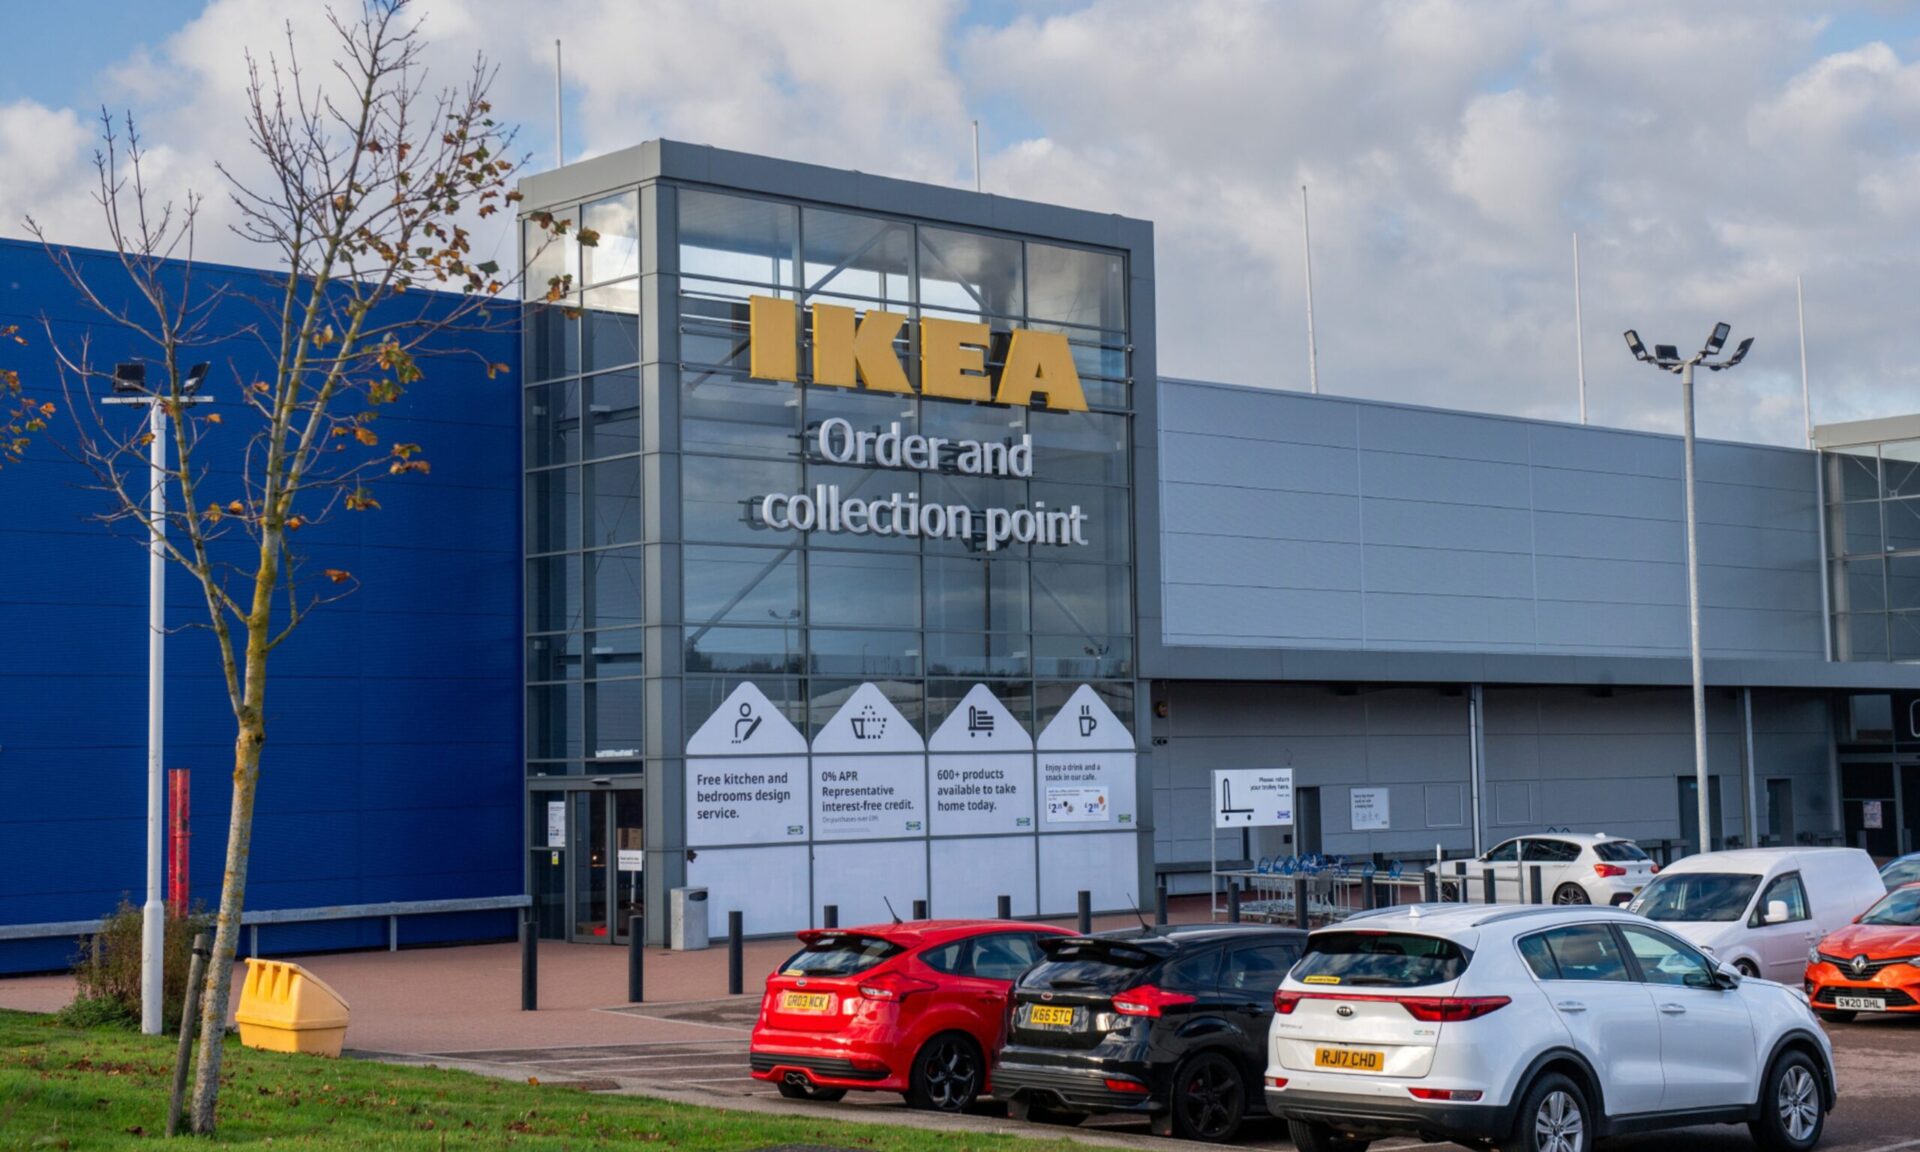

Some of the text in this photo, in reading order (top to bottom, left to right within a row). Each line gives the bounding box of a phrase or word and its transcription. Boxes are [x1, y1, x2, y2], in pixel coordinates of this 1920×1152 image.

[750, 294, 1089, 412] IKEA
[818, 417, 1033, 477] Order and
[761, 484, 1088, 551] collection point
[1045, 764, 1061, 773] Enjoy
[1067, 763, 1083, 771] drink
[1084, 763, 1096, 771] and
[697, 772, 788, 785] Free kitchen and
[822, 771, 858, 782] 0% APR
[937, 768, 1004, 783] 600+ products
[697, 789, 791, 803] bedrooms design
[822, 785, 894, 799] Representative
[937, 783, 1016, 796] available to take
[822, 799, 914, 812] interest-free credit.
[937, 799, 997, 813] home today.
[697, 807, 740, 819] service.
[1839, 998, 1881, 1009] SW20 DHL
[1033, 1008, 1071, 1022] K66 STC
[1321, 1050, 1376, 1067] RJ17 CHD
